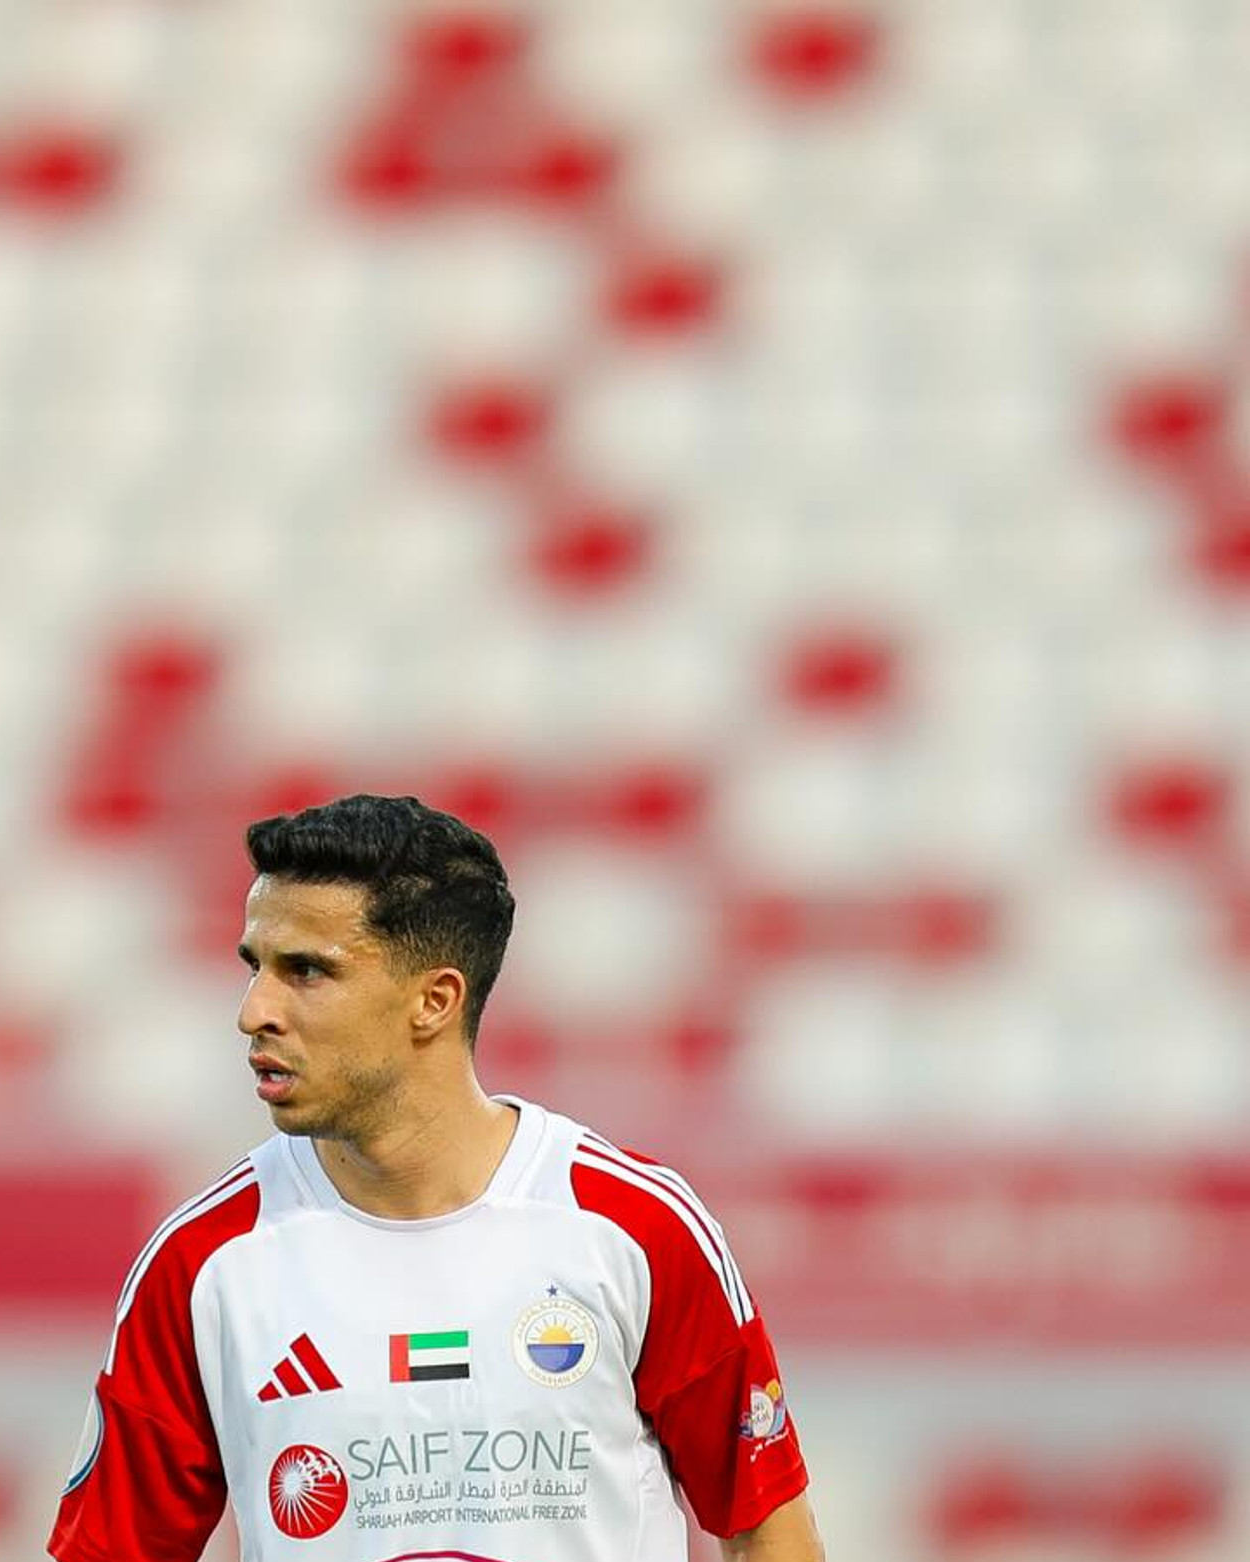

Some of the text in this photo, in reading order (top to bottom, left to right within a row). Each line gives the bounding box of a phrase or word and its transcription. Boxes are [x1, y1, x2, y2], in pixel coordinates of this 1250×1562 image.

[347, 1430, 591, 1480] SAIF ZONE
[356, 1514, 403, 1528] SHARJAH
[403, 1507, 452, 1526] AIRPORT
[454, 1506, 530, 1523] INTERNATIONAL
[532, 1504, 559, 1520] FREE
